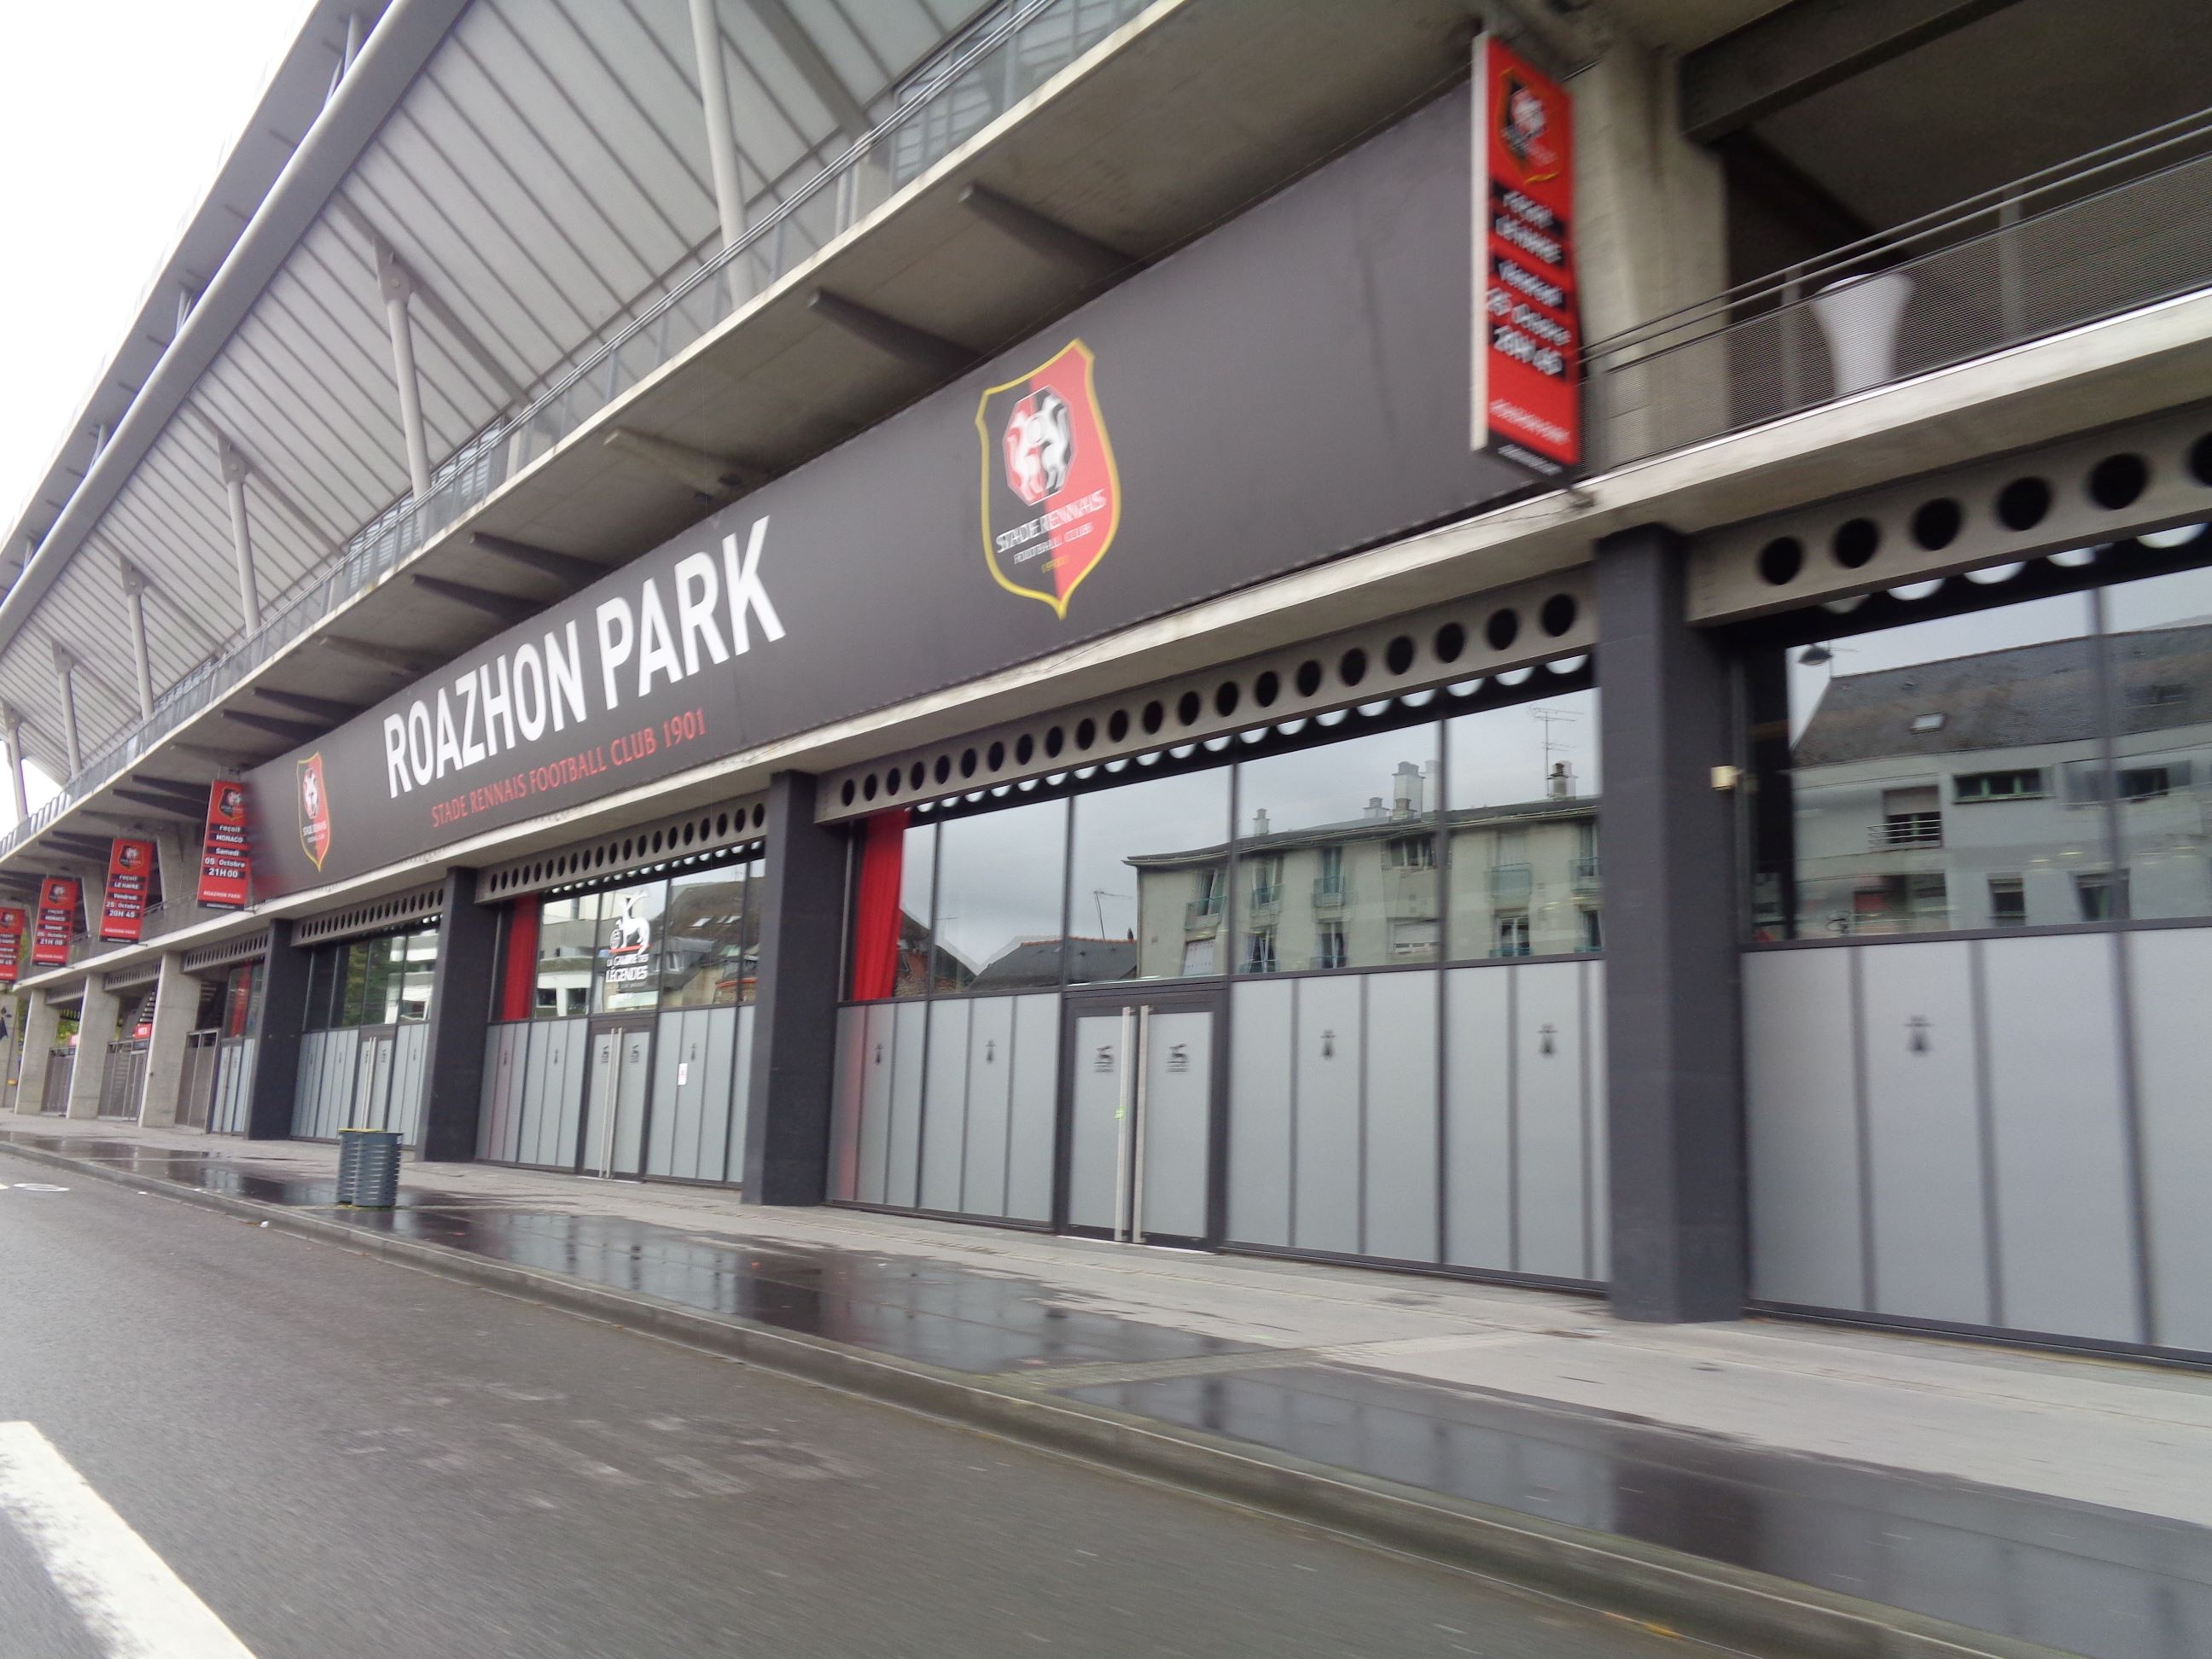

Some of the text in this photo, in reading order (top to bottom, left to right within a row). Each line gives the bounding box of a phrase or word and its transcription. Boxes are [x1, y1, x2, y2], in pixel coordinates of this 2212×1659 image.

[995, 489, 1107, 553] STADE RENNAIS
[383, 515, 786, 799] ROAZHON PARK
[431, 707, 707, 827] STADE RENNAIS FOOTBALL CLUB 1901
[215, 834, 244, 843] MONACO
[215, 848, 239, 857] Samedi
[204, 857, 247, 868] 05 Octobre
